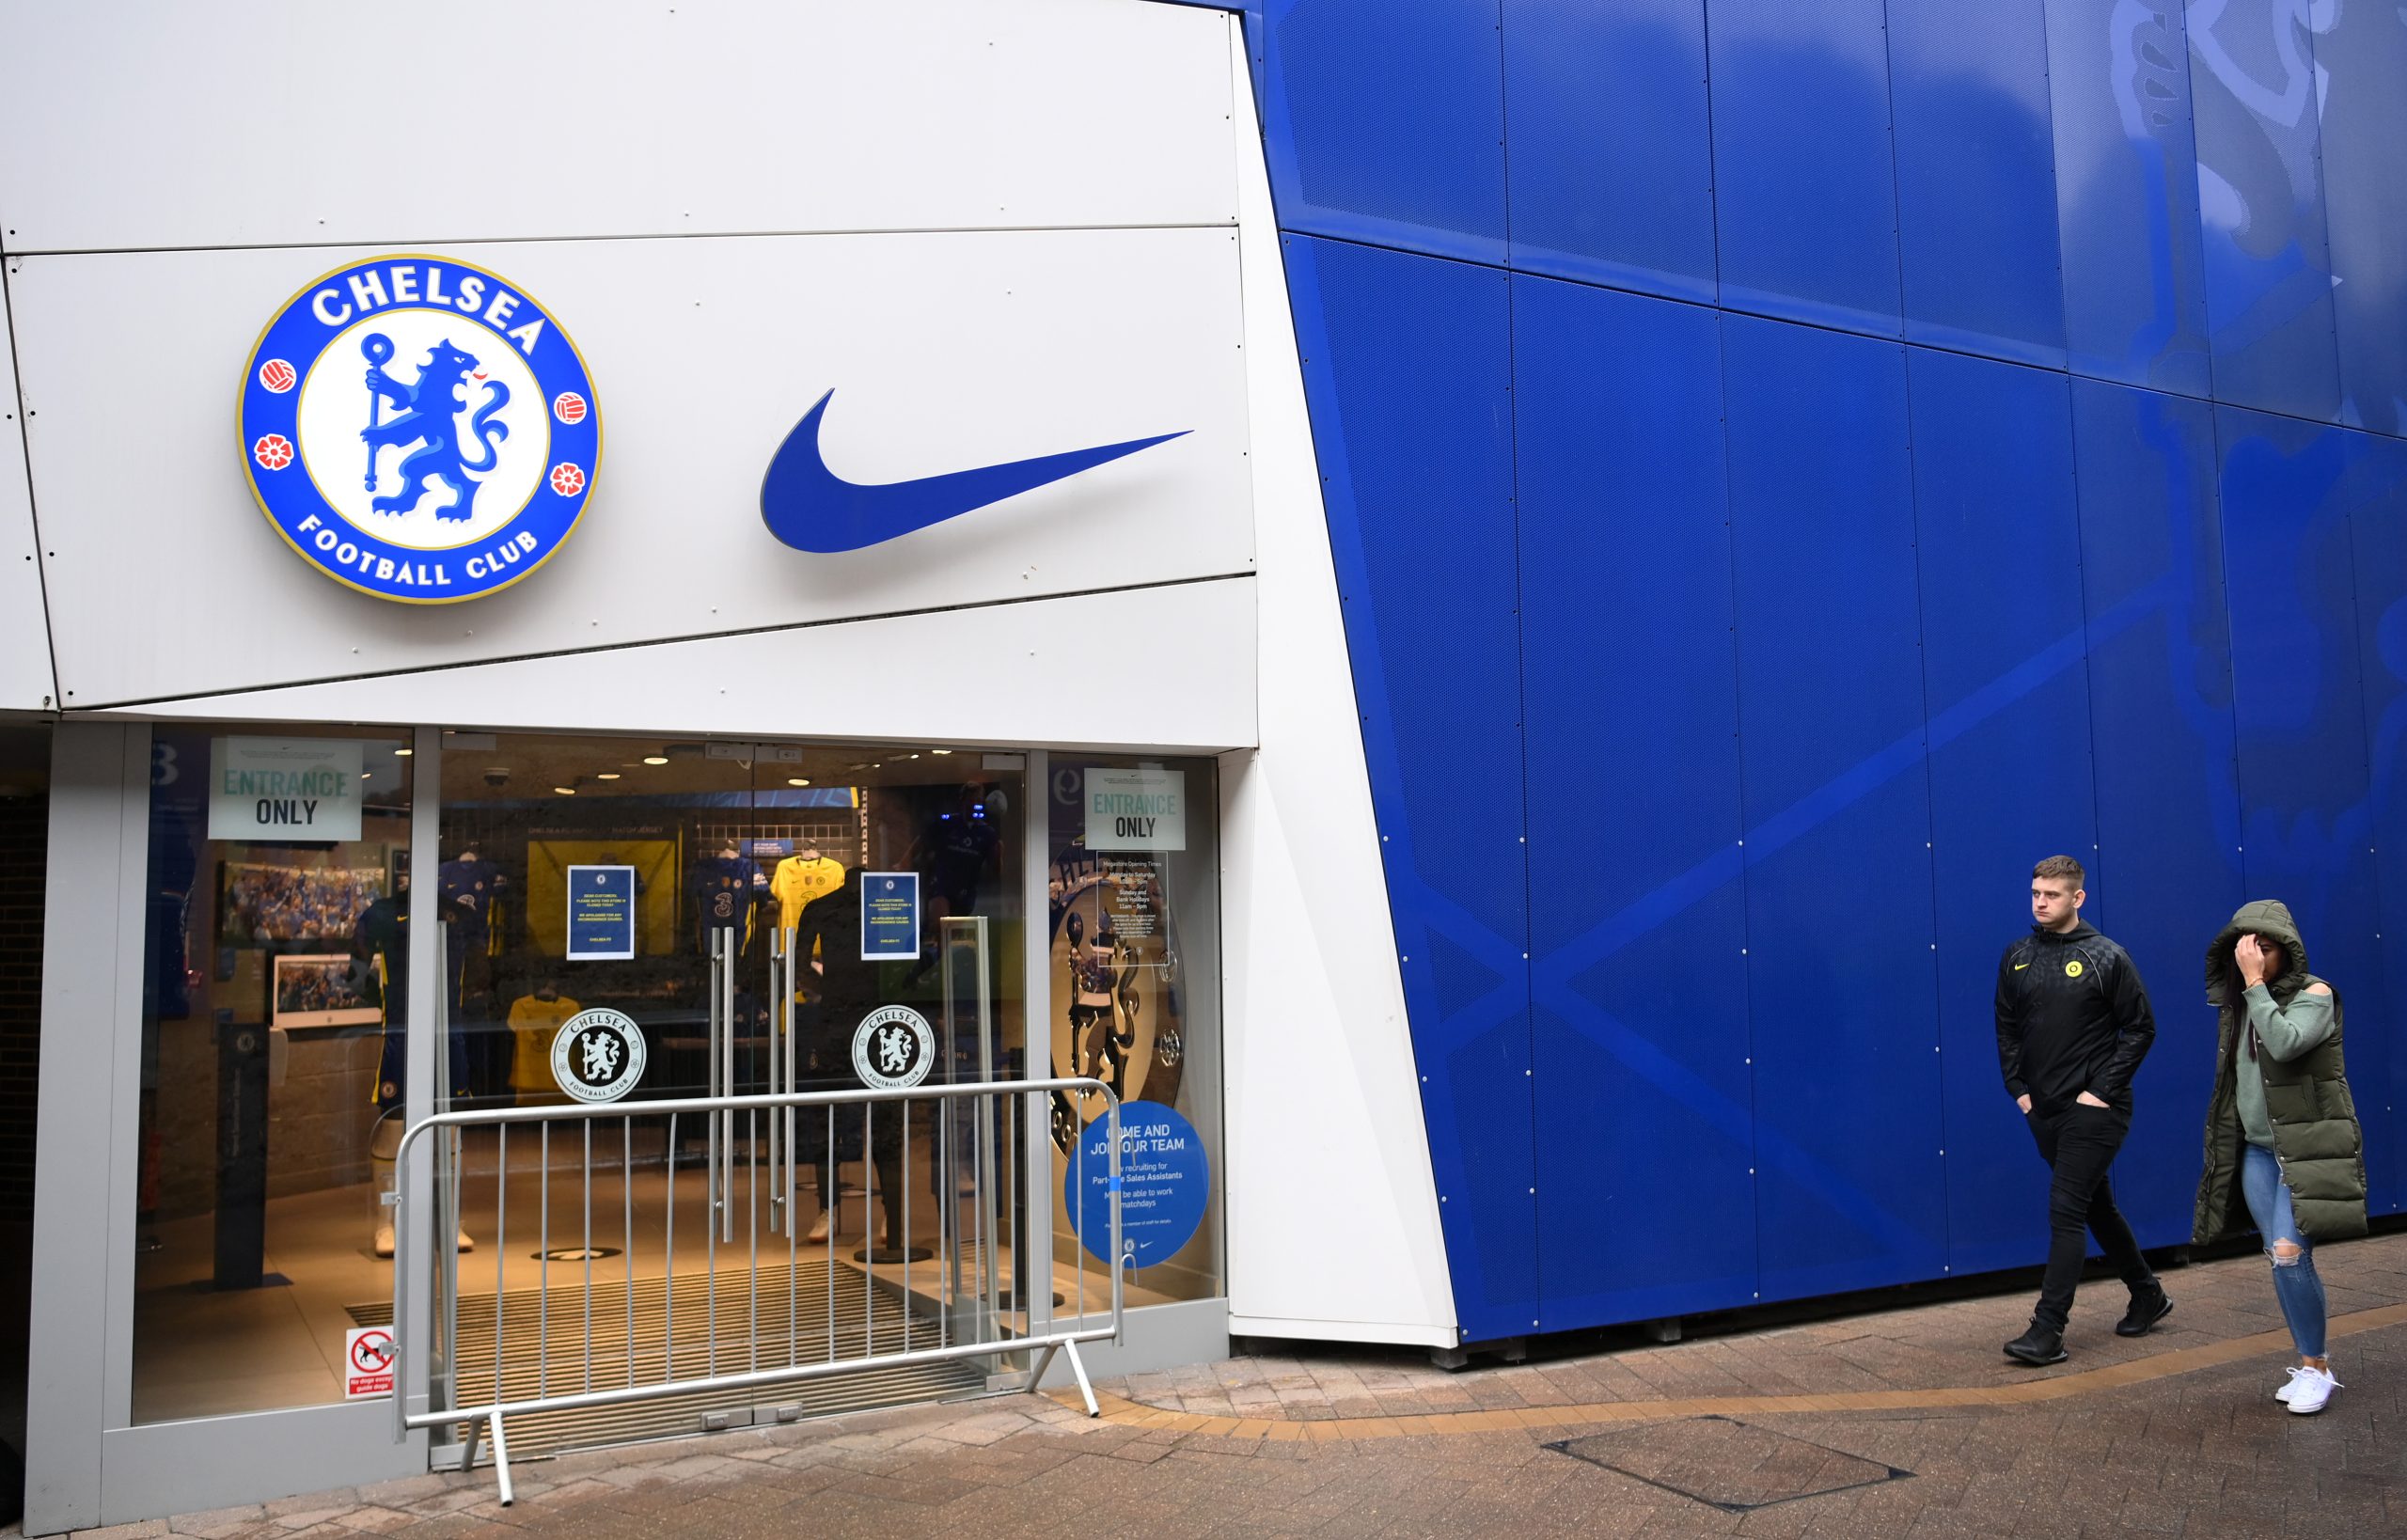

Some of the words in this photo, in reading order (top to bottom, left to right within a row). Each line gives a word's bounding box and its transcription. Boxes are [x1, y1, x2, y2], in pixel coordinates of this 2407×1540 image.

[312, 266, 546, 356] CHELSEA
[297, 513, 451, 586] FOOTBALL
[465, 529, 538, 578] CLUB
[223, 770, 349, 796] ENTRANCE
[256, 799, 318, 825] ONLY
[1093, 793, 1176, 815] ENTRANCE
[1115, 817, 1156, 838] ONLY
[570, 1014, 627, 1033] CHELSEA
[868, 1011, 918, 1029] CHELSEA
[569, 1081, 607, 1096] FOOTBALL
[610, 1078, 628, 1092] CLUB
[868, 1073, 901, 1087] FOOTBALL
[904, 1070, 920, 1084] CLUB
[1143, 1124, 1171, 1138] AND
[1122, 1139, 1148, 1154] OUR
[1151, 1138, 1185, 1151] TEAM
[1125, 1163, 1157, 1172] recruiting
[1093, 1176, 1125, 1185] Part-e
[1126, 1173, 1145, 1182] Sales
[1146, 1171, 1183, 1181] Assistants
[1132, 1189, 1147, 1198] able
[1156, 1186, 1173, 1196] work
[1121, 1200, 1156, 1209] matchdays
